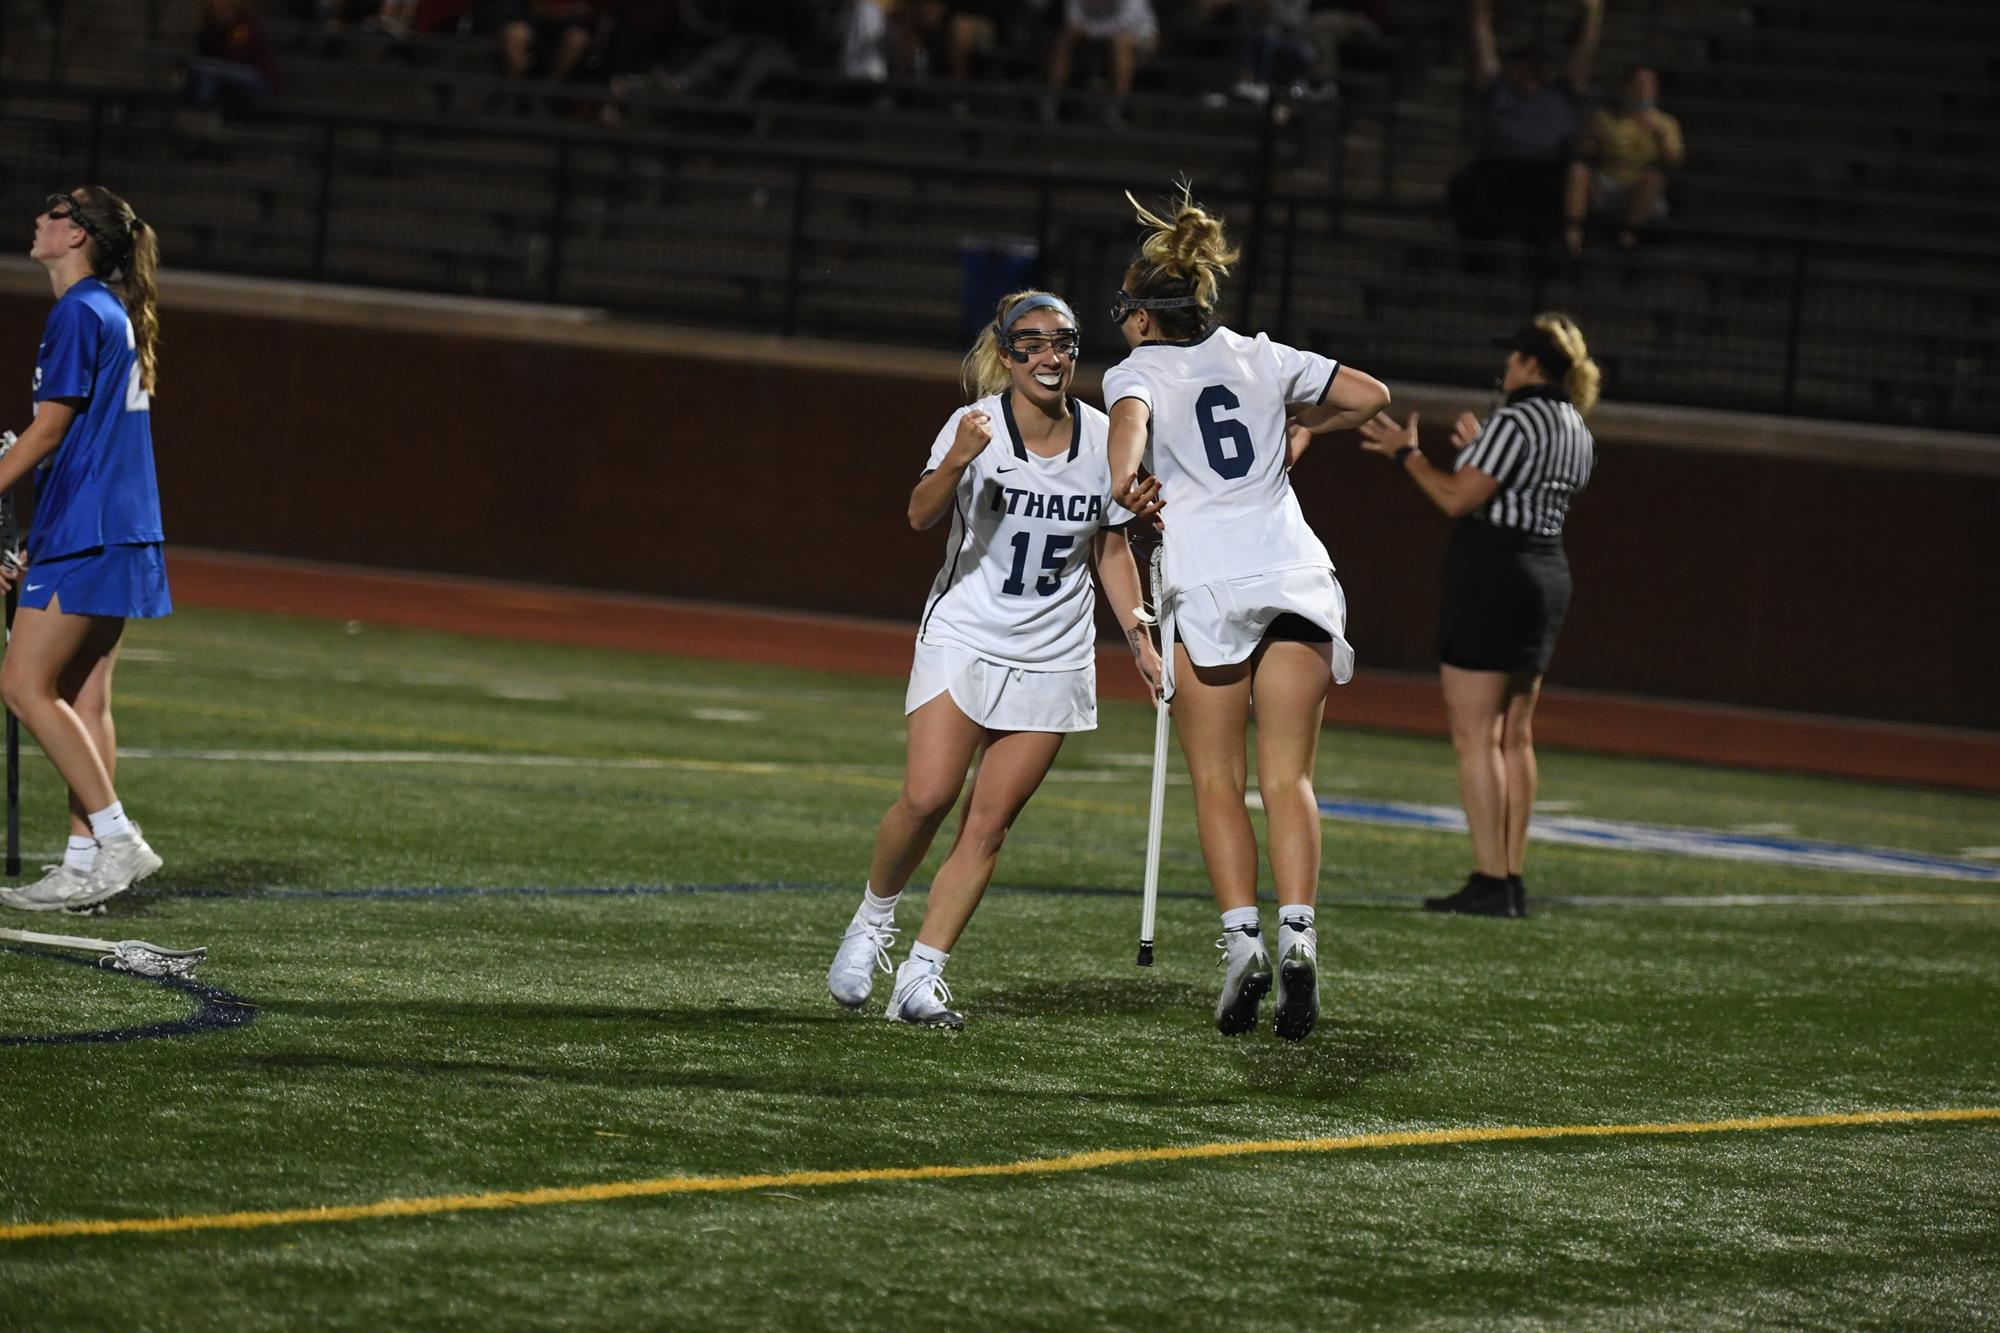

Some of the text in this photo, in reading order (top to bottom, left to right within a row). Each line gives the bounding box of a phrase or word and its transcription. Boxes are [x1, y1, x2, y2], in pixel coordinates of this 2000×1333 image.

[1195, 384, 1255, 480] 6
[991, 485, 1102, 522] ITHACA
[1002, 531, 1075, 596] 15
